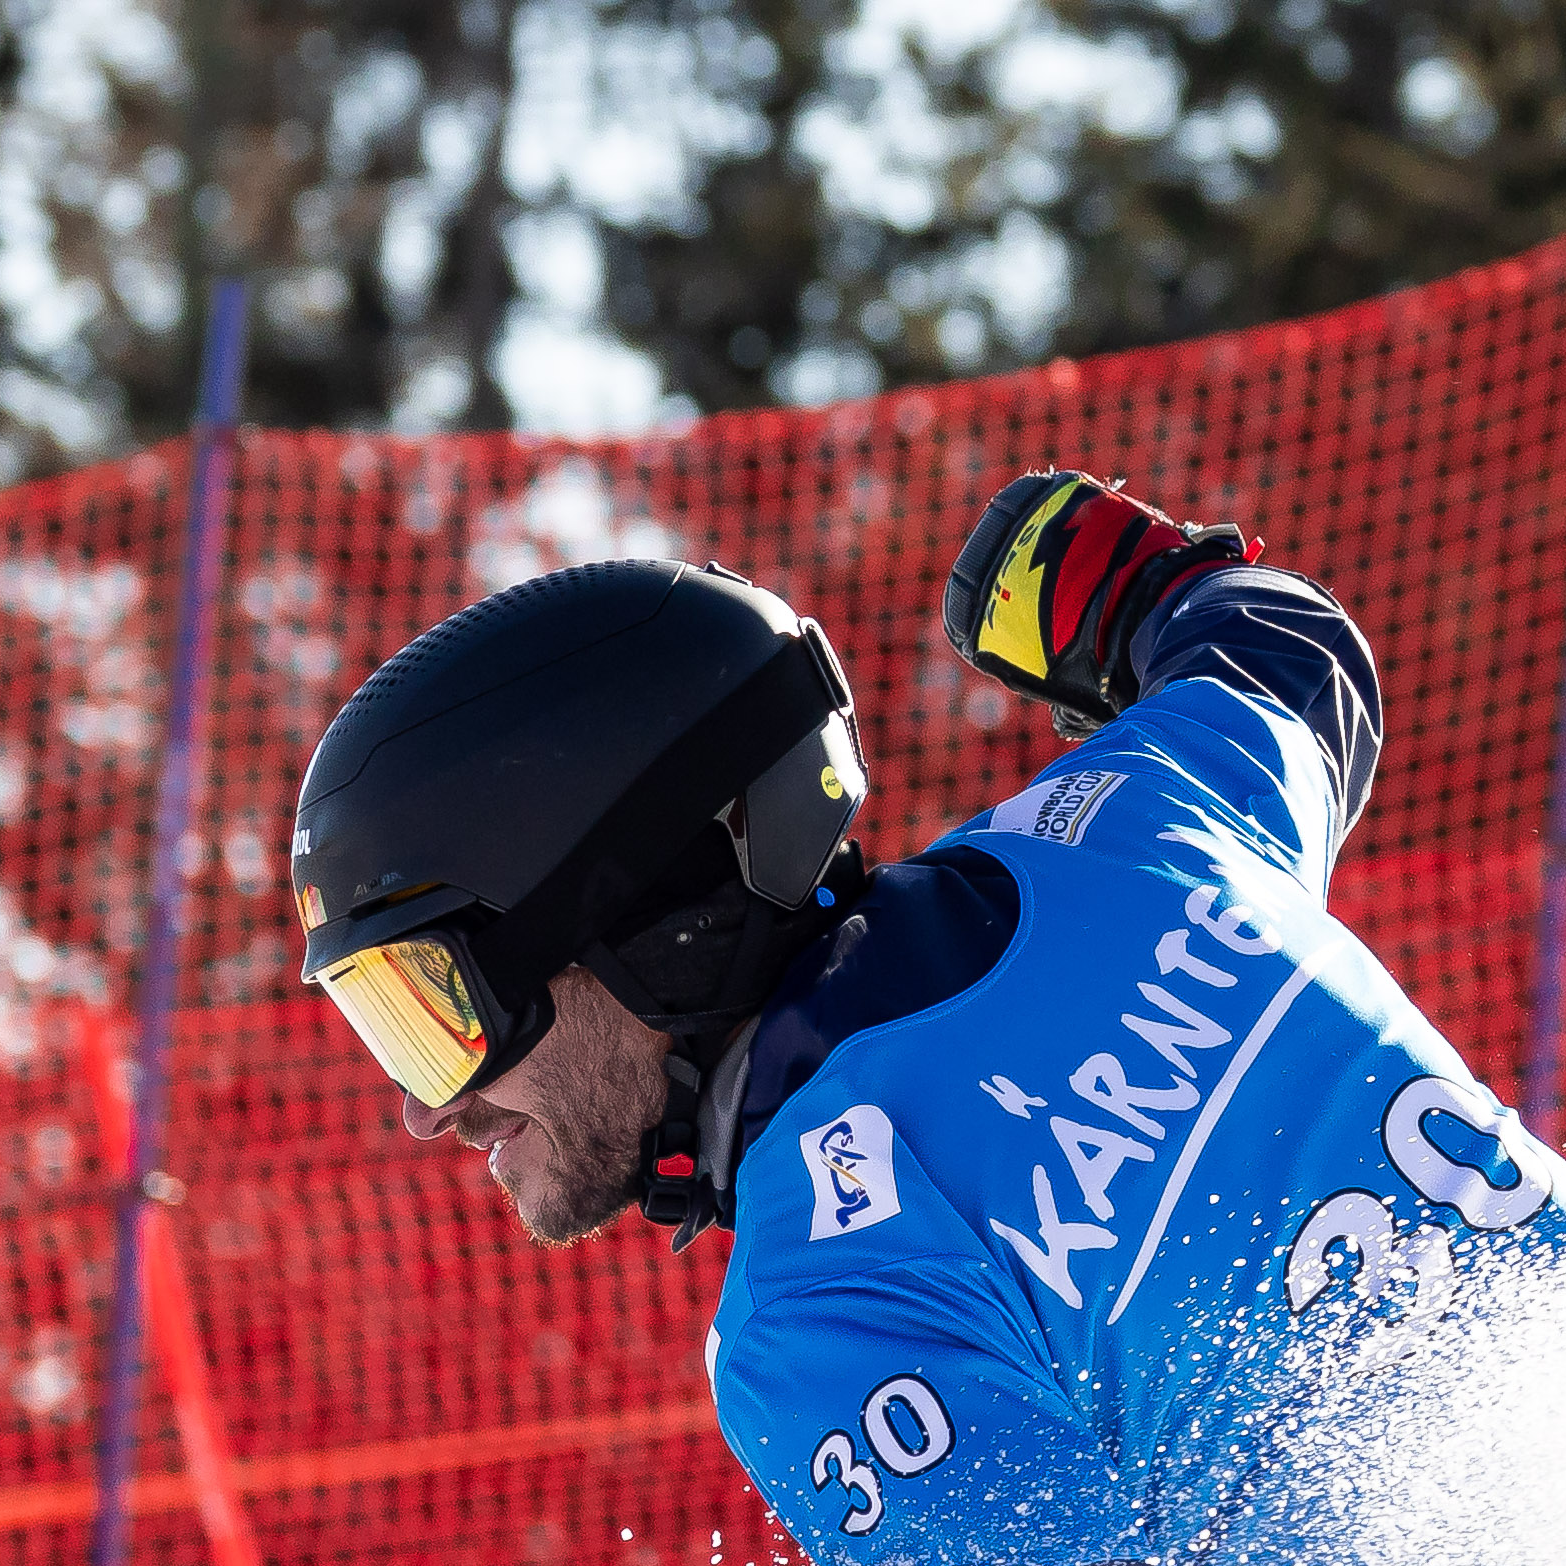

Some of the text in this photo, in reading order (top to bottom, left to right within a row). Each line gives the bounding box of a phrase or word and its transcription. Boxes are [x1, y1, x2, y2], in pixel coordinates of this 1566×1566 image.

[980, 866, 1283, 1310] KÄRNTE
[1284, 1073, 1554, 1376] 30
[810, 1372, 957, 1538] 30
